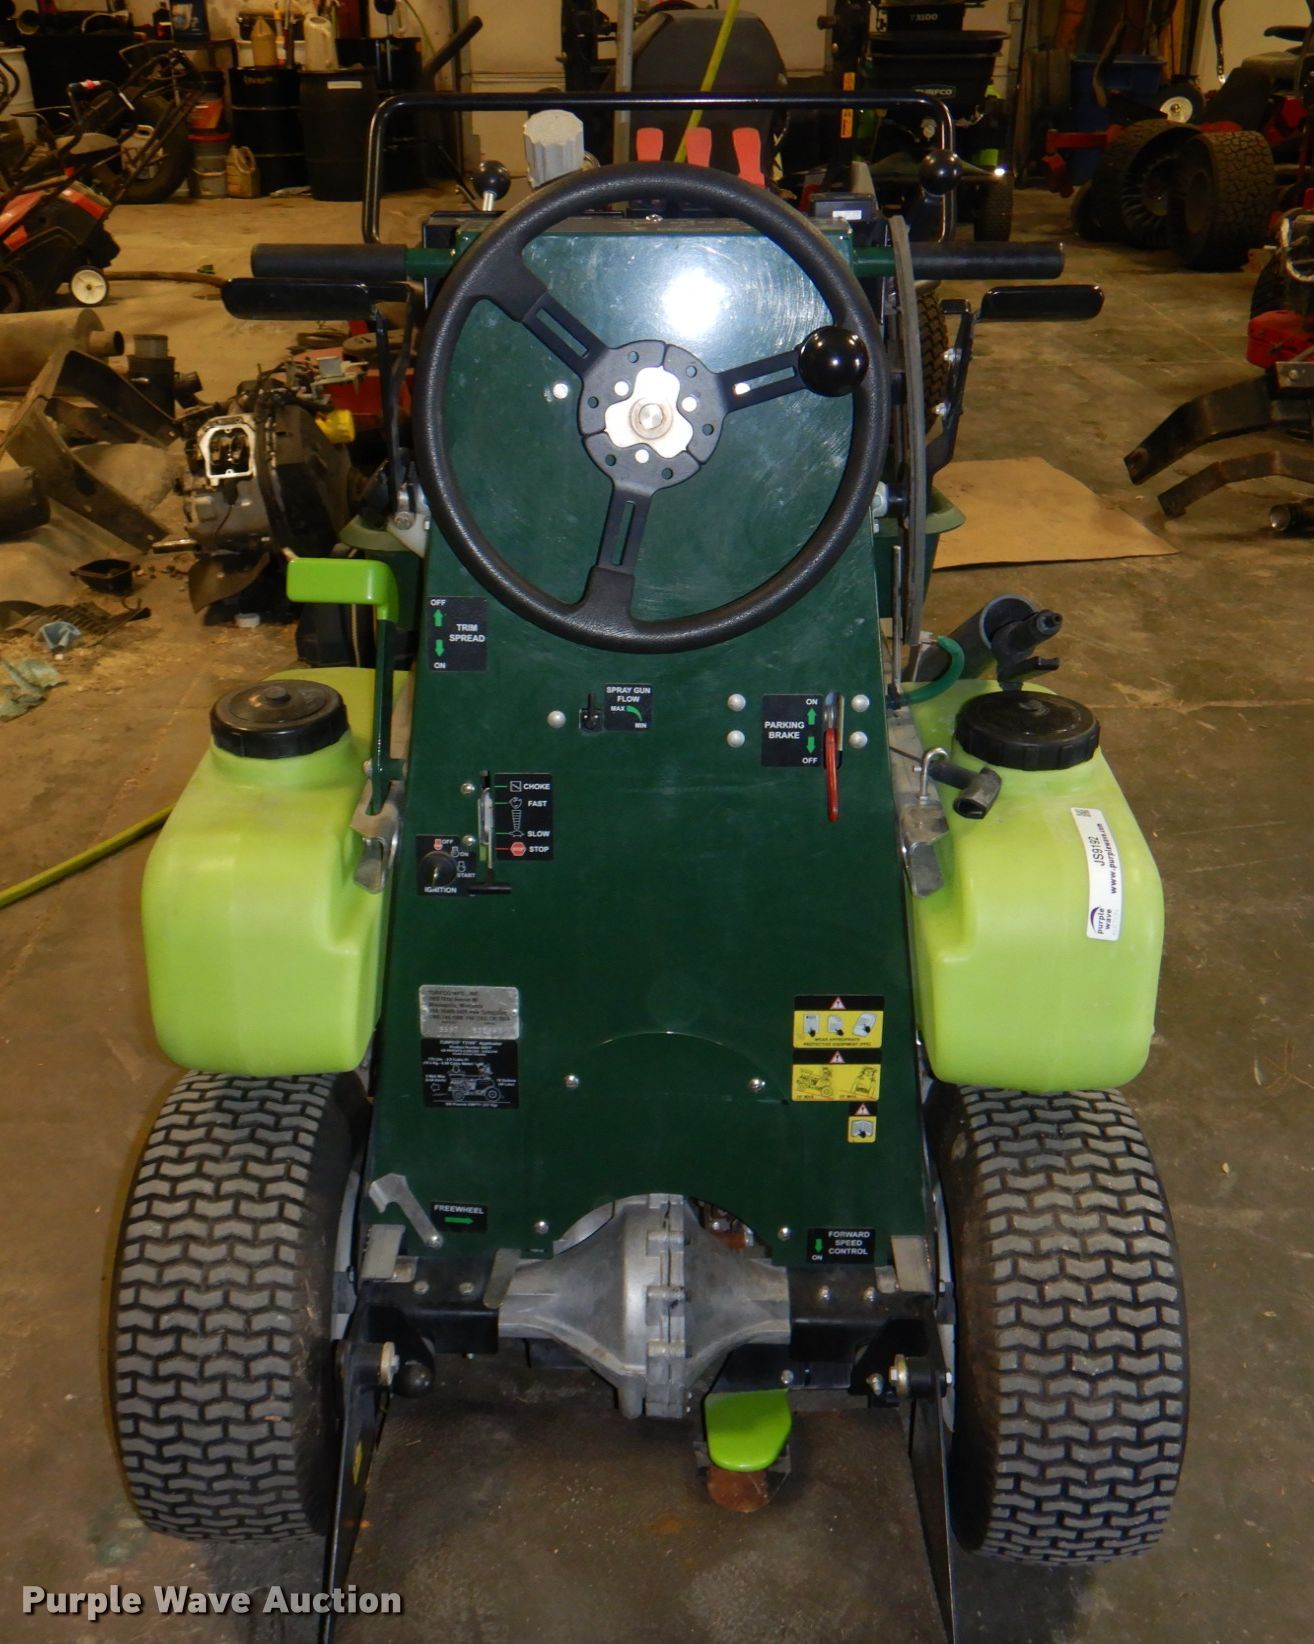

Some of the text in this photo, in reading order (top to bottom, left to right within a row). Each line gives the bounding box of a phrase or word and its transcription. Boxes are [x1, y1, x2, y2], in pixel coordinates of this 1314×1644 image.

[456, 623, 478, 632] TRIM
[449, 634, 485, 642] SPREAD
[606, 686, 632, 694] SPRAY
[617, 695, 640, 703] FLOW
[764, 721, 805, 729] PARKING
[768, 731, 800, 739] BRAKE
[1088, 836, 1105, 867] JS9192
[1096, 823, 1118, 894] www.purplewave.com
[1097, 908, 1106, 934] purple
[434, 1204, 484, 1215] FREEWHEEL
